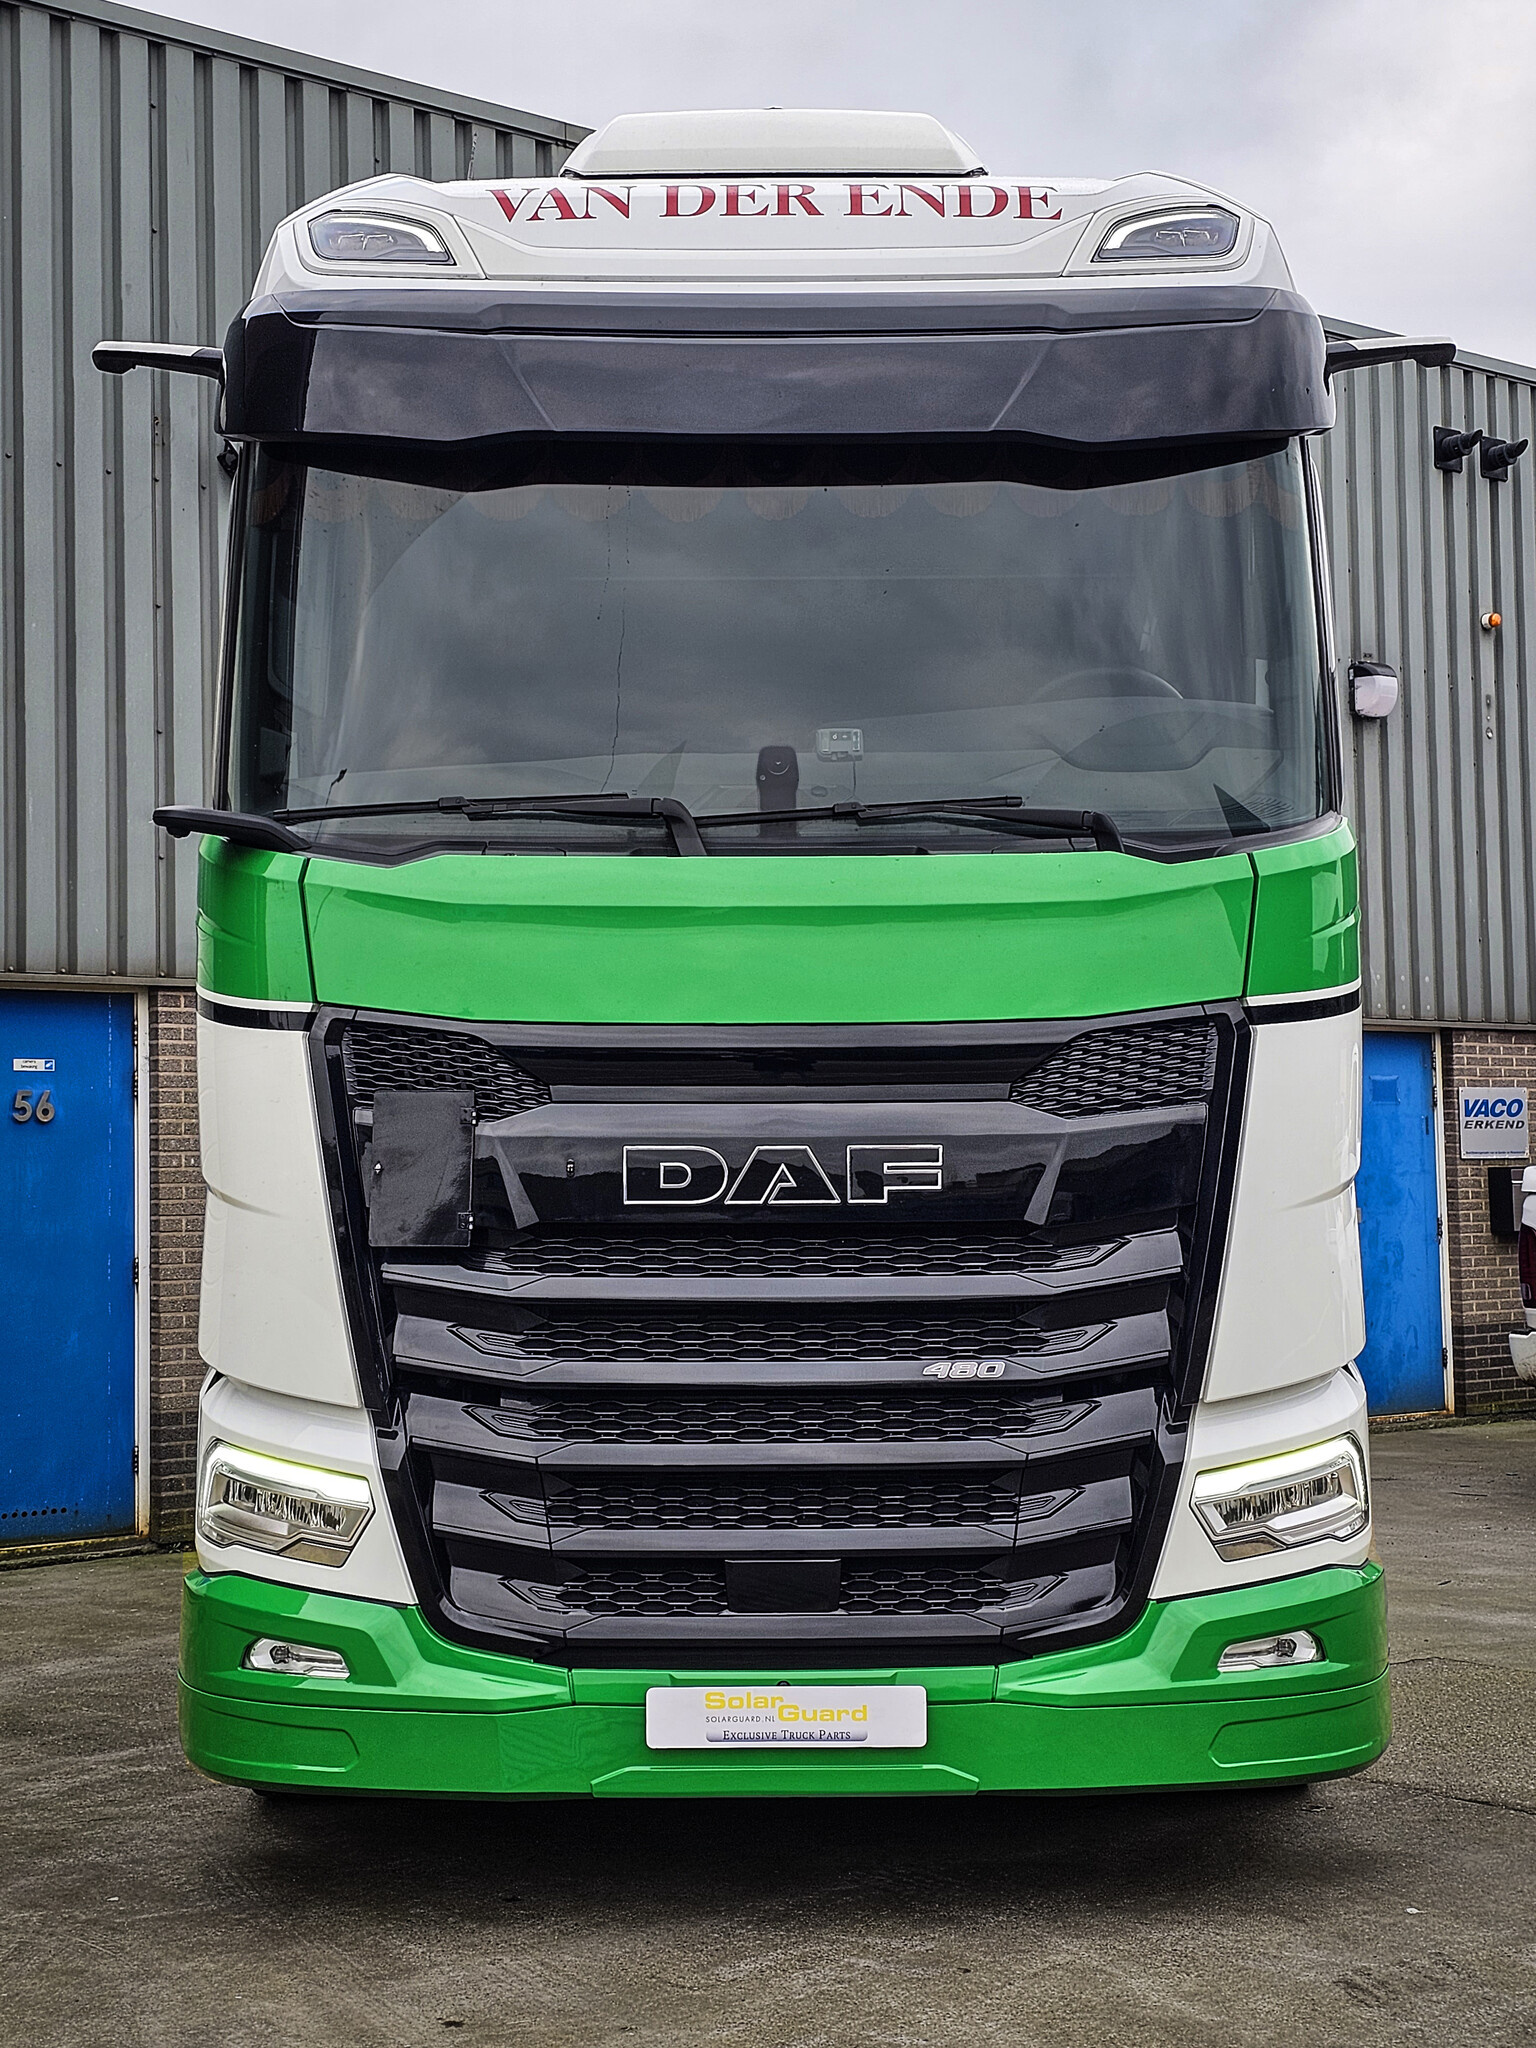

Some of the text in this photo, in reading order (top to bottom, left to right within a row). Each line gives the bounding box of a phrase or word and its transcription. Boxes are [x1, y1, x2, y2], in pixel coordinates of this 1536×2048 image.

[485, 184, 1063, 222] VAN DER ENDE
[13, 1090, 55, 1122] 56
[1464, 1099, 1524, 1118] VACO
[1464, 1120, 1525, 1129] ERKEND
[622, 1145, 944, 1206] DAF
[922, 1361, 1006, 1379] 480
[705, 1691, 784, 1710] Solar
[777, 1704, 868, 1722] Guard
